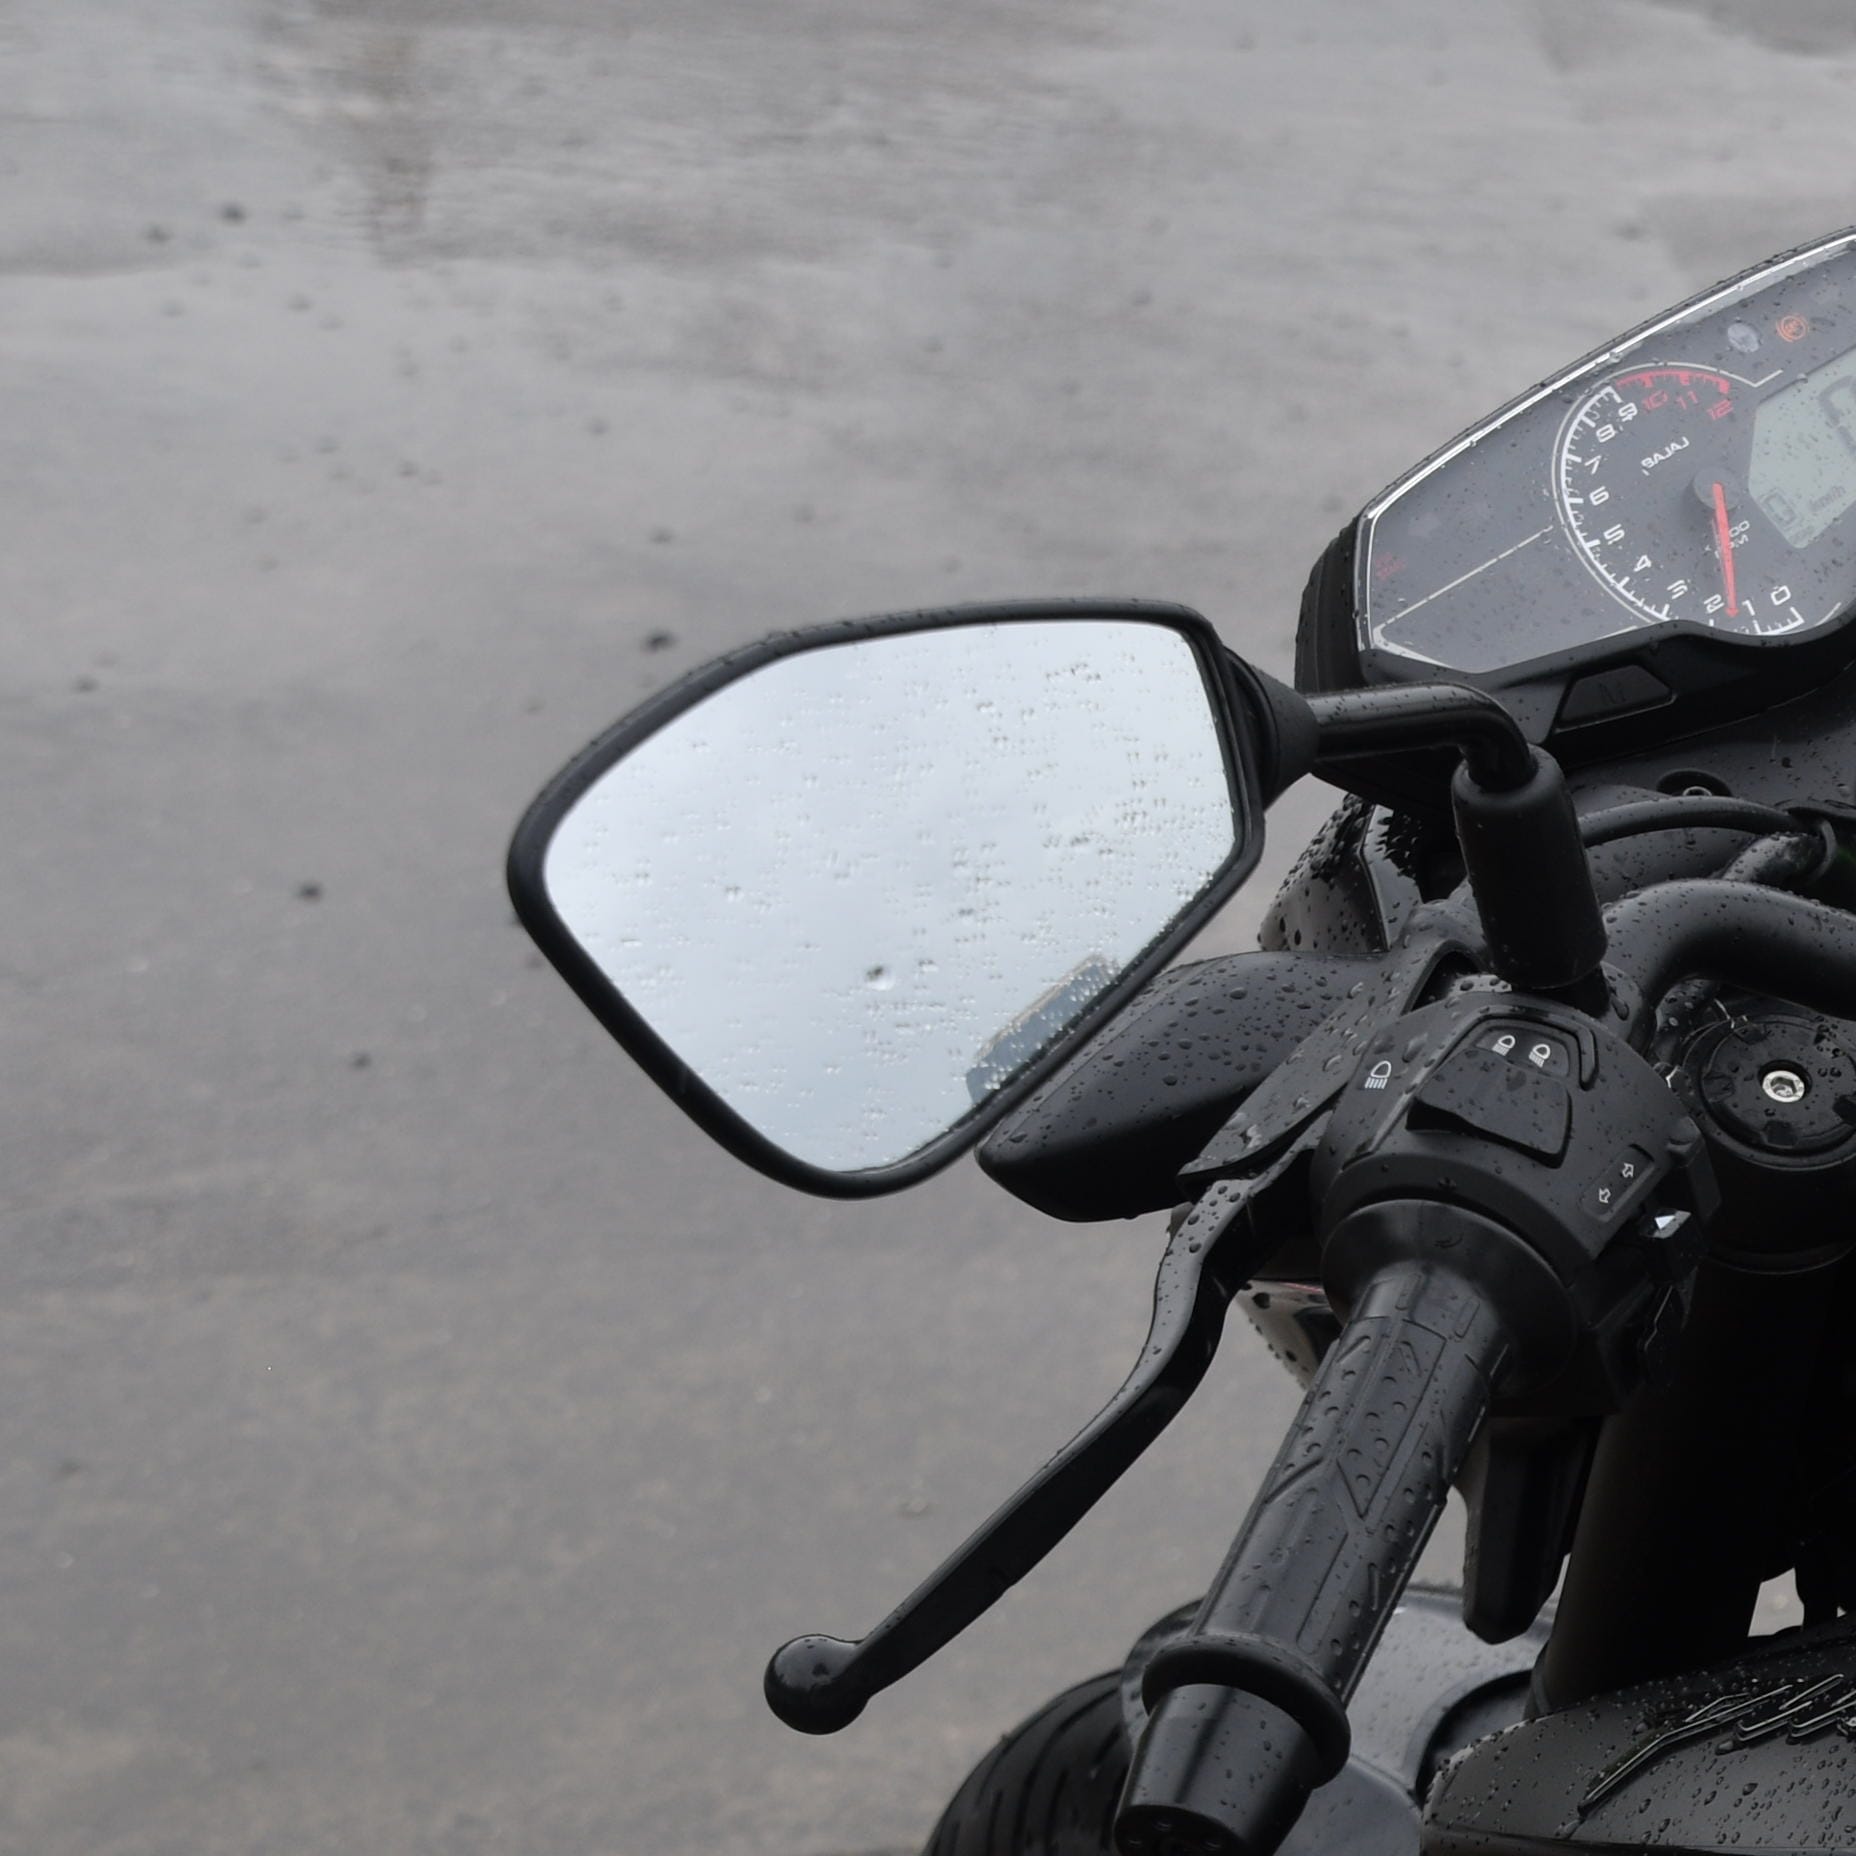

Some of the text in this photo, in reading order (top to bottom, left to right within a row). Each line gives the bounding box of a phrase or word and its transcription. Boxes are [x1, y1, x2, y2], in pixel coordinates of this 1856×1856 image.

[1642, 390, 1668, 411] 10
[1675, 390, 1700, 411] 11
[1706, 399, 1734, 421] 12
[1618, 402, 1638, 422] 9
[1596, 423, 1617, 443] 8
[1641, 436, 1690, 470] BAJAJ
[1584, 454, 1602, 475] 7
[1589, 486, 1610, 506] 6
[1603, 524, 1625, 545] 5
[1633, 554, 1652, 572] 4
[1667, 579, 1688, 600] 3
[1771, 585, 1791, 606] 0
[1704, 594, 1725, 614] 2
[1742, 599, 1756, 617] 1
